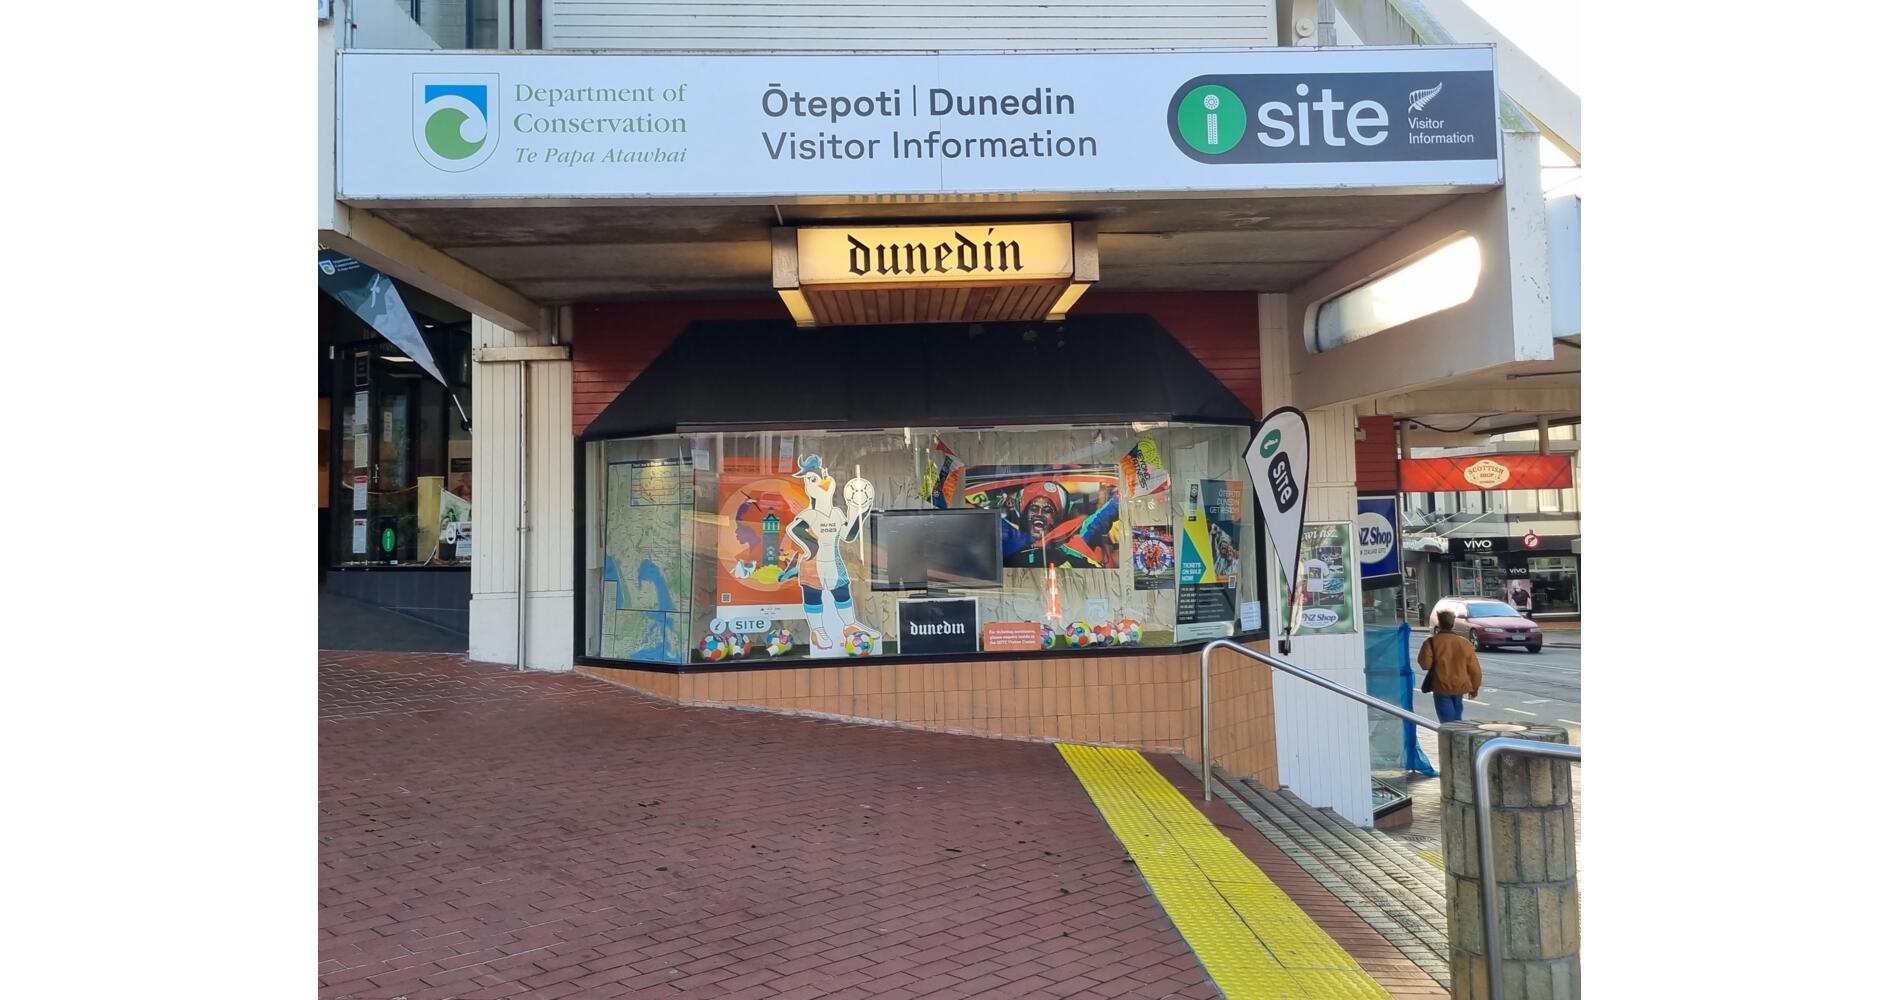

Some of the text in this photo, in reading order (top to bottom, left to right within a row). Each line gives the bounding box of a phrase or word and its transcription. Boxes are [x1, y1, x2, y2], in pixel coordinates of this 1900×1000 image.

[514, 83, 688, 108] Department of
[761, 82, 1076, 124] Ōtepoti Dunedin
[513, 112, 688, 134] Conservation
[1256, 82, 1390, 148] site
[1407, 116, 1445, 130] Visitor
[761, 129, 1098, 161] Visitor Information
[1408, 131, 1475, 145] Information
[515, 147, 688, 168] Te Papa Atawhai
[846, 228, 1025, 276] dunedin
[1370, 526, 1392, 548] Shop
[1317, 613, 1337, 623] Shop
